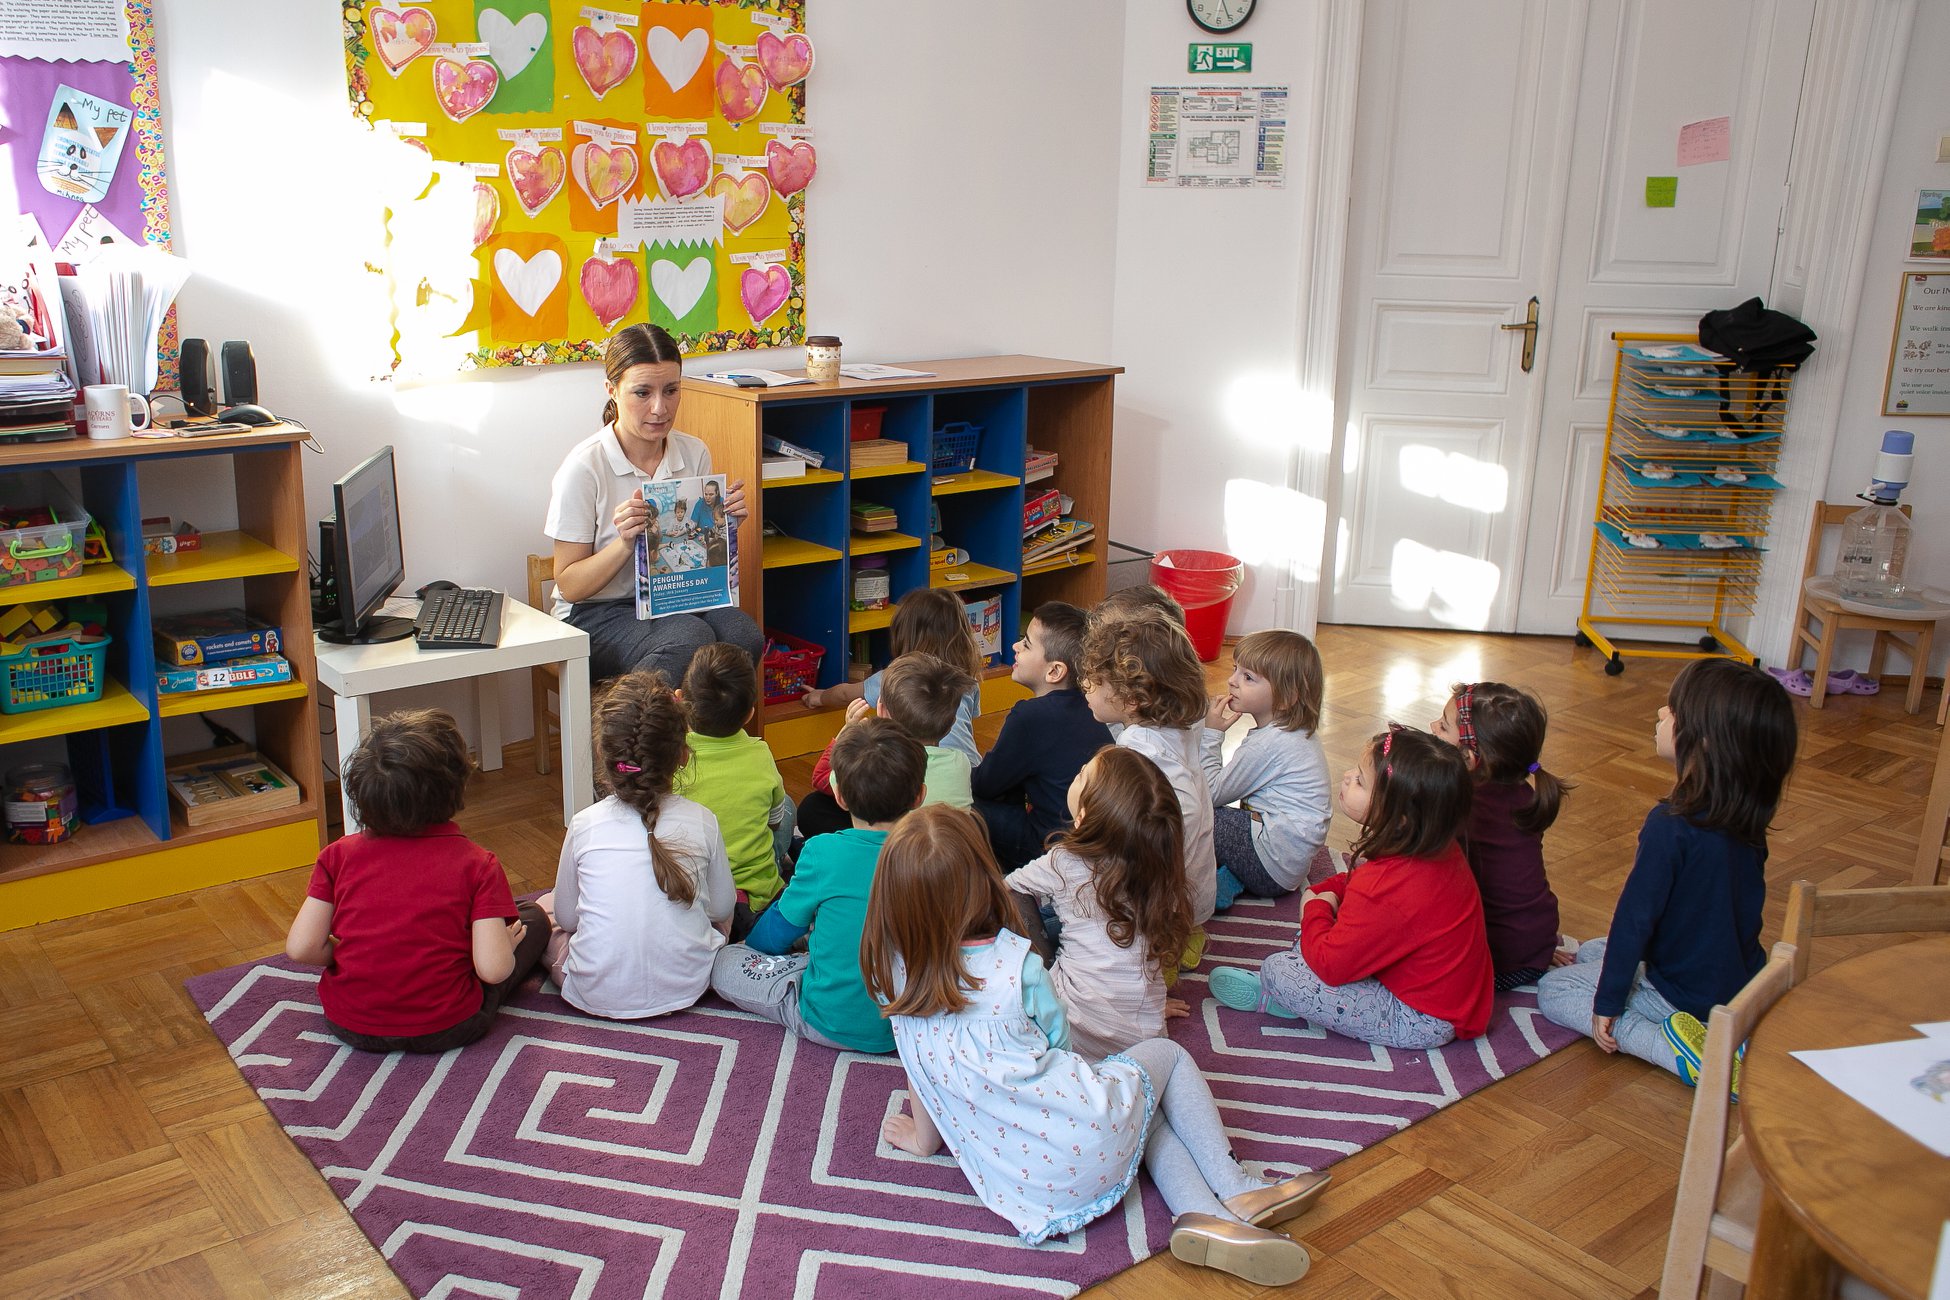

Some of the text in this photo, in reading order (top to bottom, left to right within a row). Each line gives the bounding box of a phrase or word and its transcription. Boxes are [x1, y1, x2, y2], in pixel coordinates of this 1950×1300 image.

[1216, 47, 1240, 58] EXIT
[82, 98, 128, 123] My pet
[79, 204, 99, 238] pet
[653, 574, 684, 584] PENGUIN
[653, 578, 708, 592] AWARENESS DAY
[766, 961, 796, 979] SPORTS
